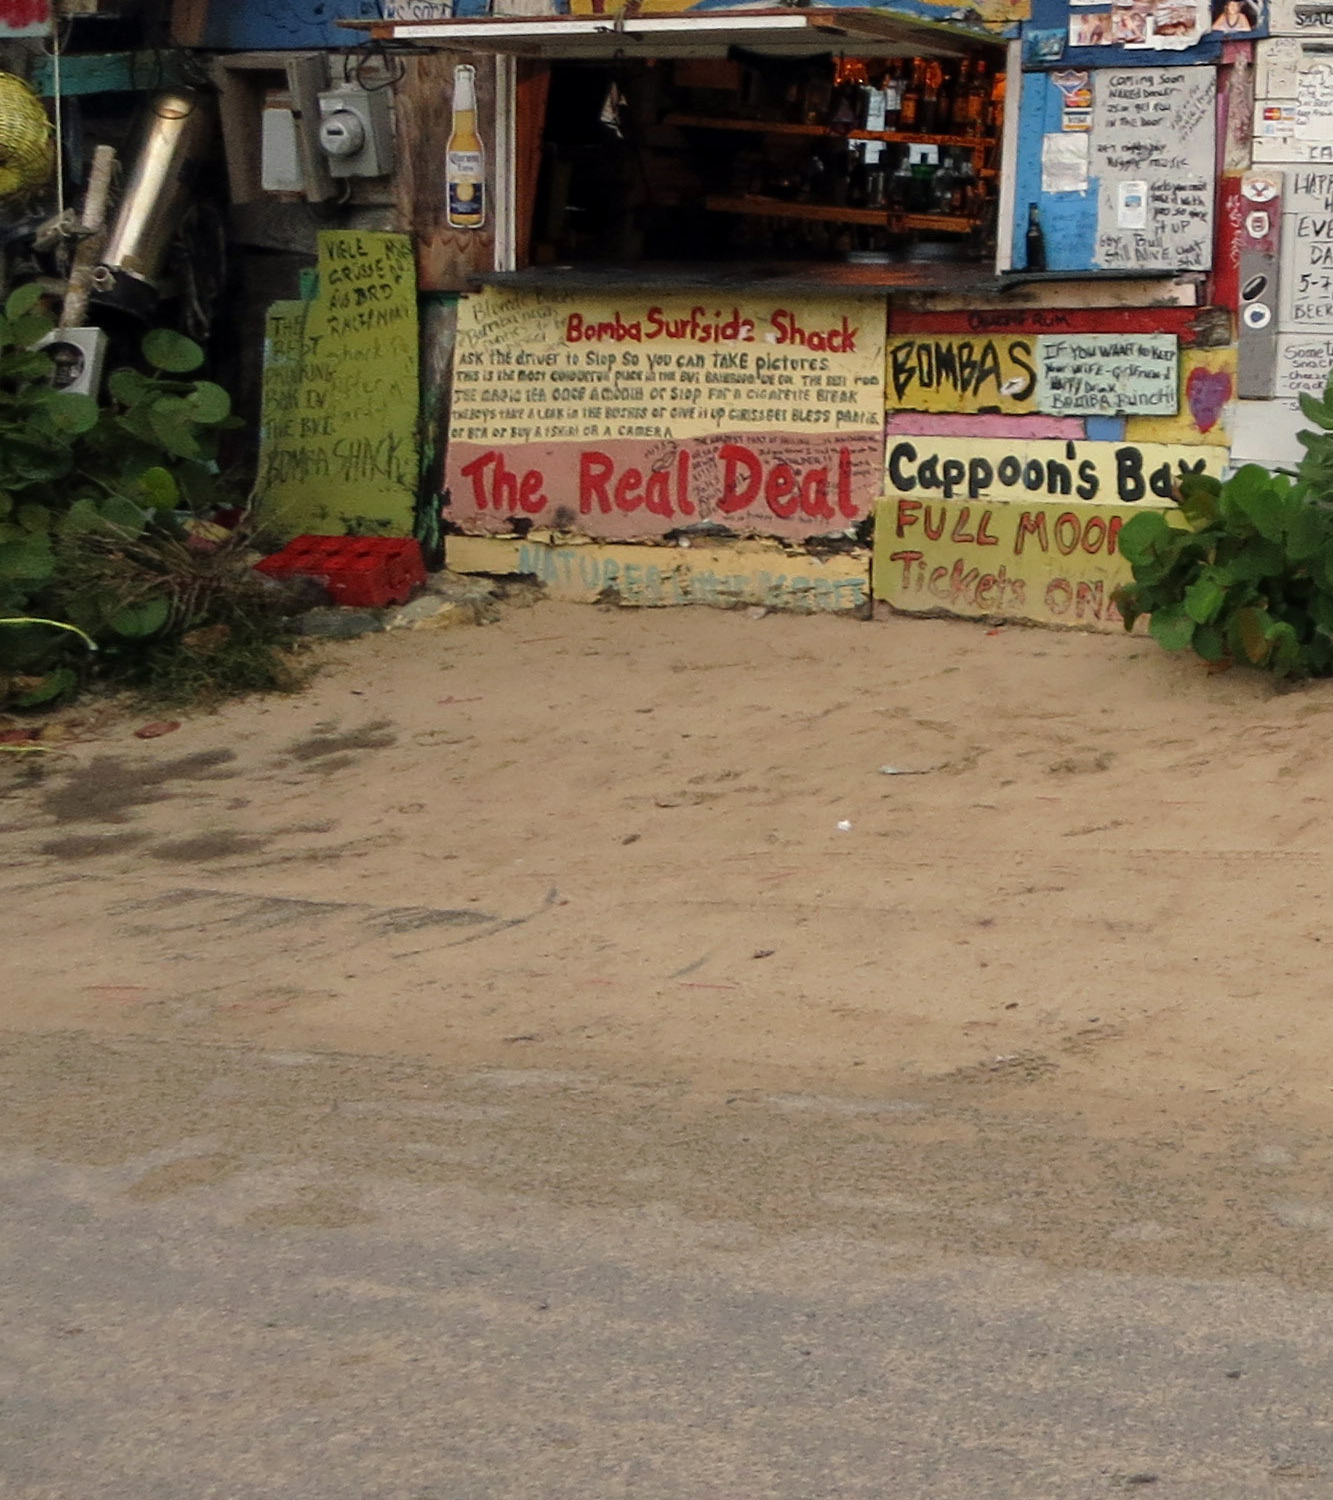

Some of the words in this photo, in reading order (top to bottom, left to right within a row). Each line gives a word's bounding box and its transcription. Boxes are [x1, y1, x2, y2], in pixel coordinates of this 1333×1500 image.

[565, 311, 643, 343] Bomba
[769, 308, 860, 354] Shack
[890, 339, 1038, 401] BOMBAS
[460, 451, 549, 515] The
[578, 449, 696, 518] Real
[717, 443, 860, 519] Deal
[888, 440, 1101, 500] Cappoon's
[896, 500, 999, 546] FULL
